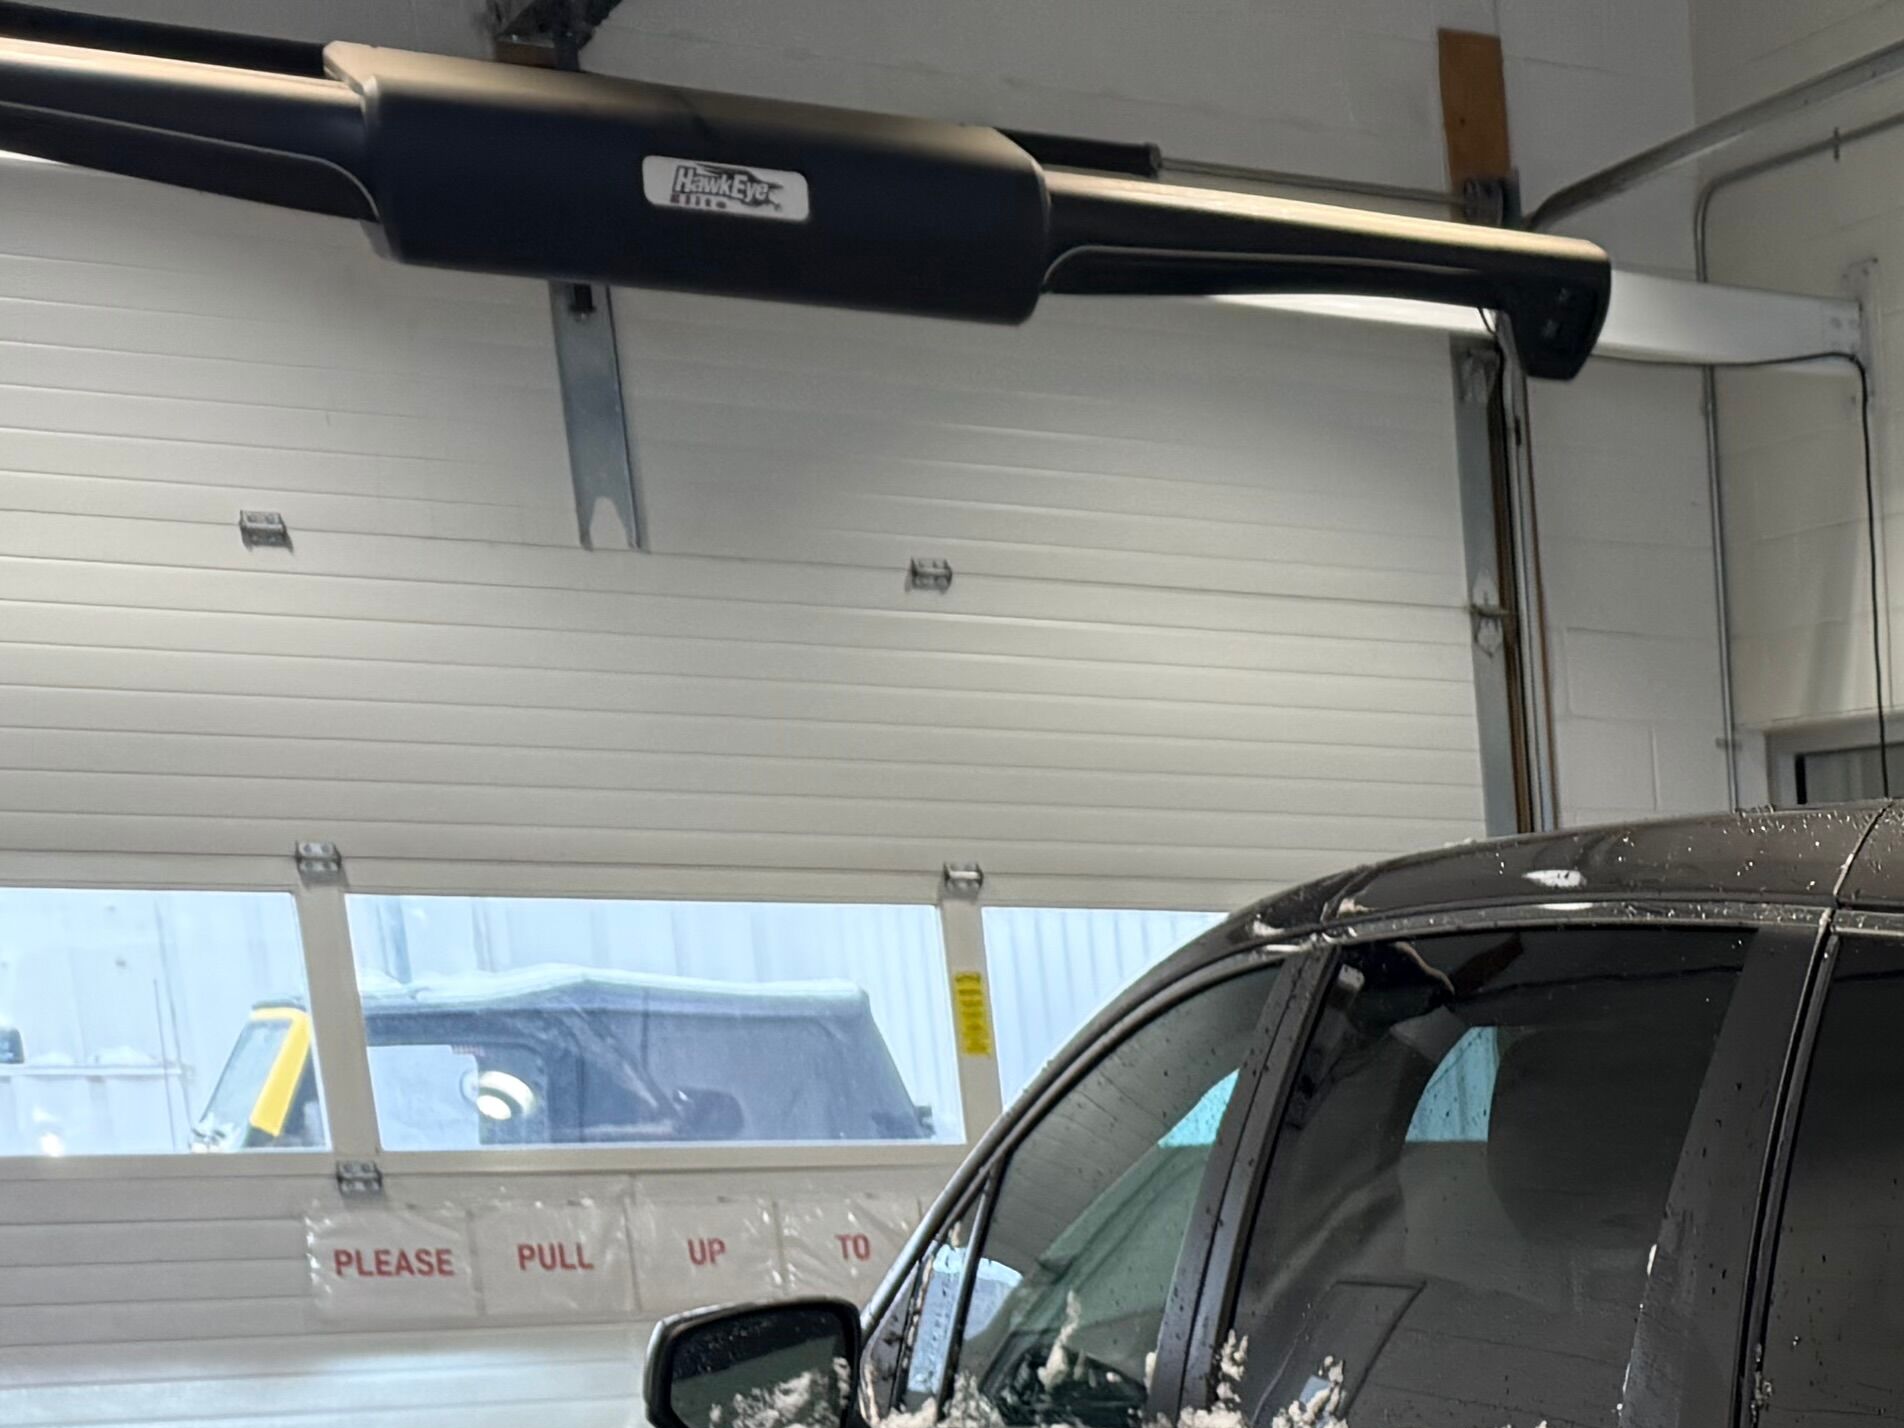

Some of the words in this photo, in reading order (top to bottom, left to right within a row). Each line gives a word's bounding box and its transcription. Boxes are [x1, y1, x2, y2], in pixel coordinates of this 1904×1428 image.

[673, 166, 770, 202] HawkEye
[333, 1247, 456, 1277] PLEASE
[517, 1241, 594, 1271] PULL
[688, 1237, 726, 1266] UP
[835, 1233, 872, 1262] TO
